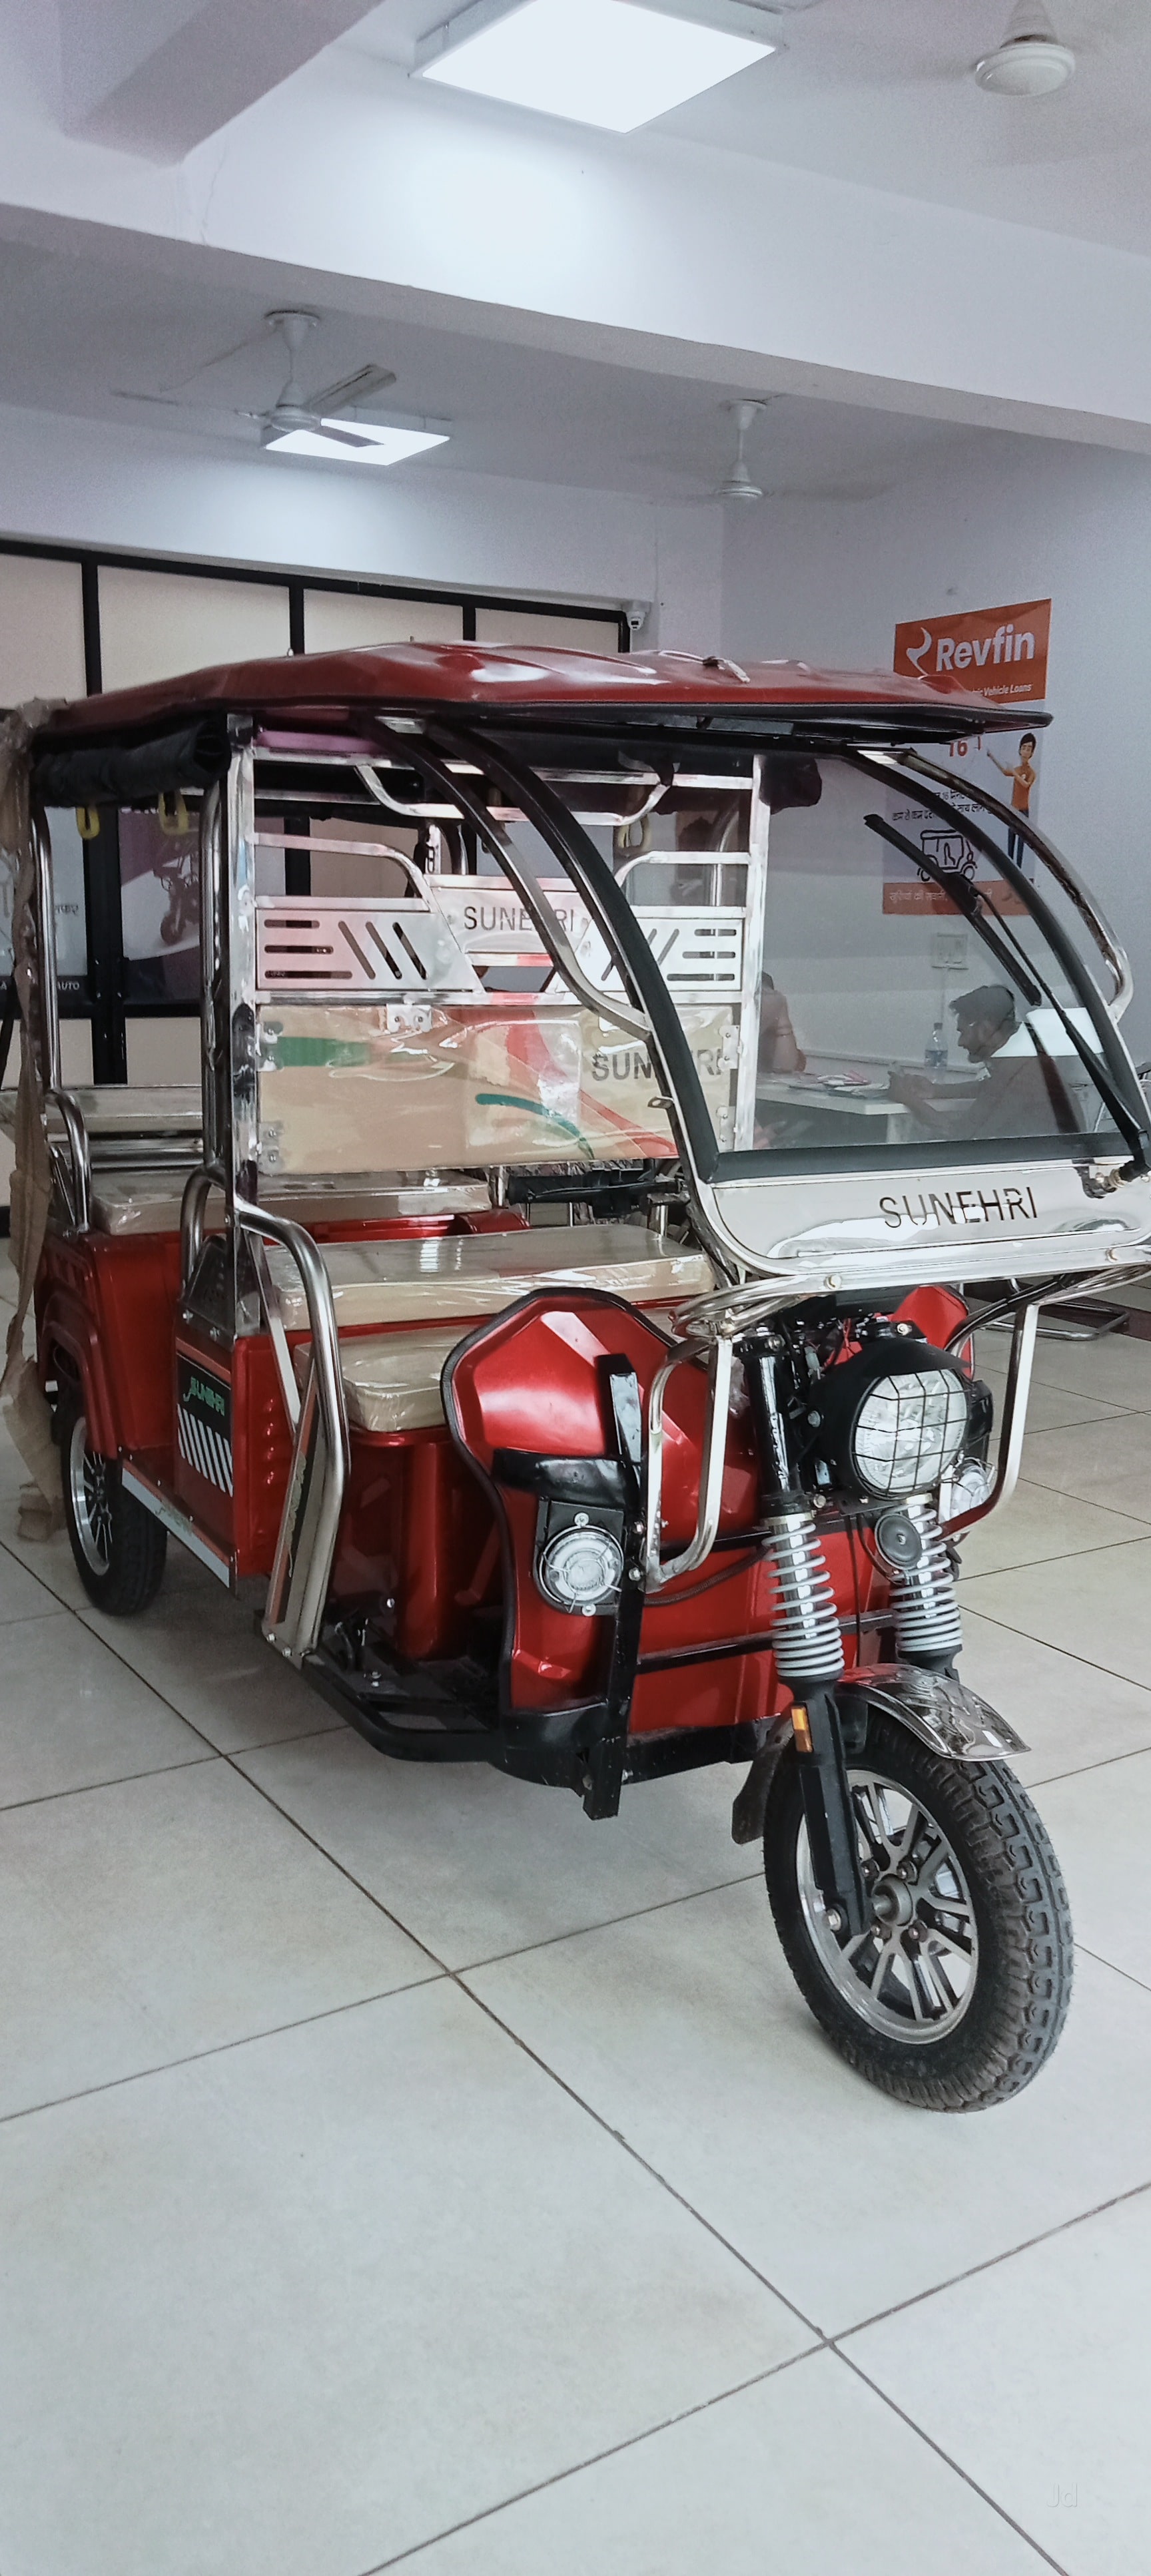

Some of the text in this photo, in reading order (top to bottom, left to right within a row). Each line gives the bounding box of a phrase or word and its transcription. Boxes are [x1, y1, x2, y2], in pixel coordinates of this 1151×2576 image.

[936, 624, 1035, 671] Revfin
[984, 685, 1008, 696] Vehicle
[1010, 684, 1032, 694] Loans
[464, 906, 574, 931] SUNERI
[591, 1048, 722, 1081] SUNRI
[879, 1186, 1038, 1228] SUNEHRI
